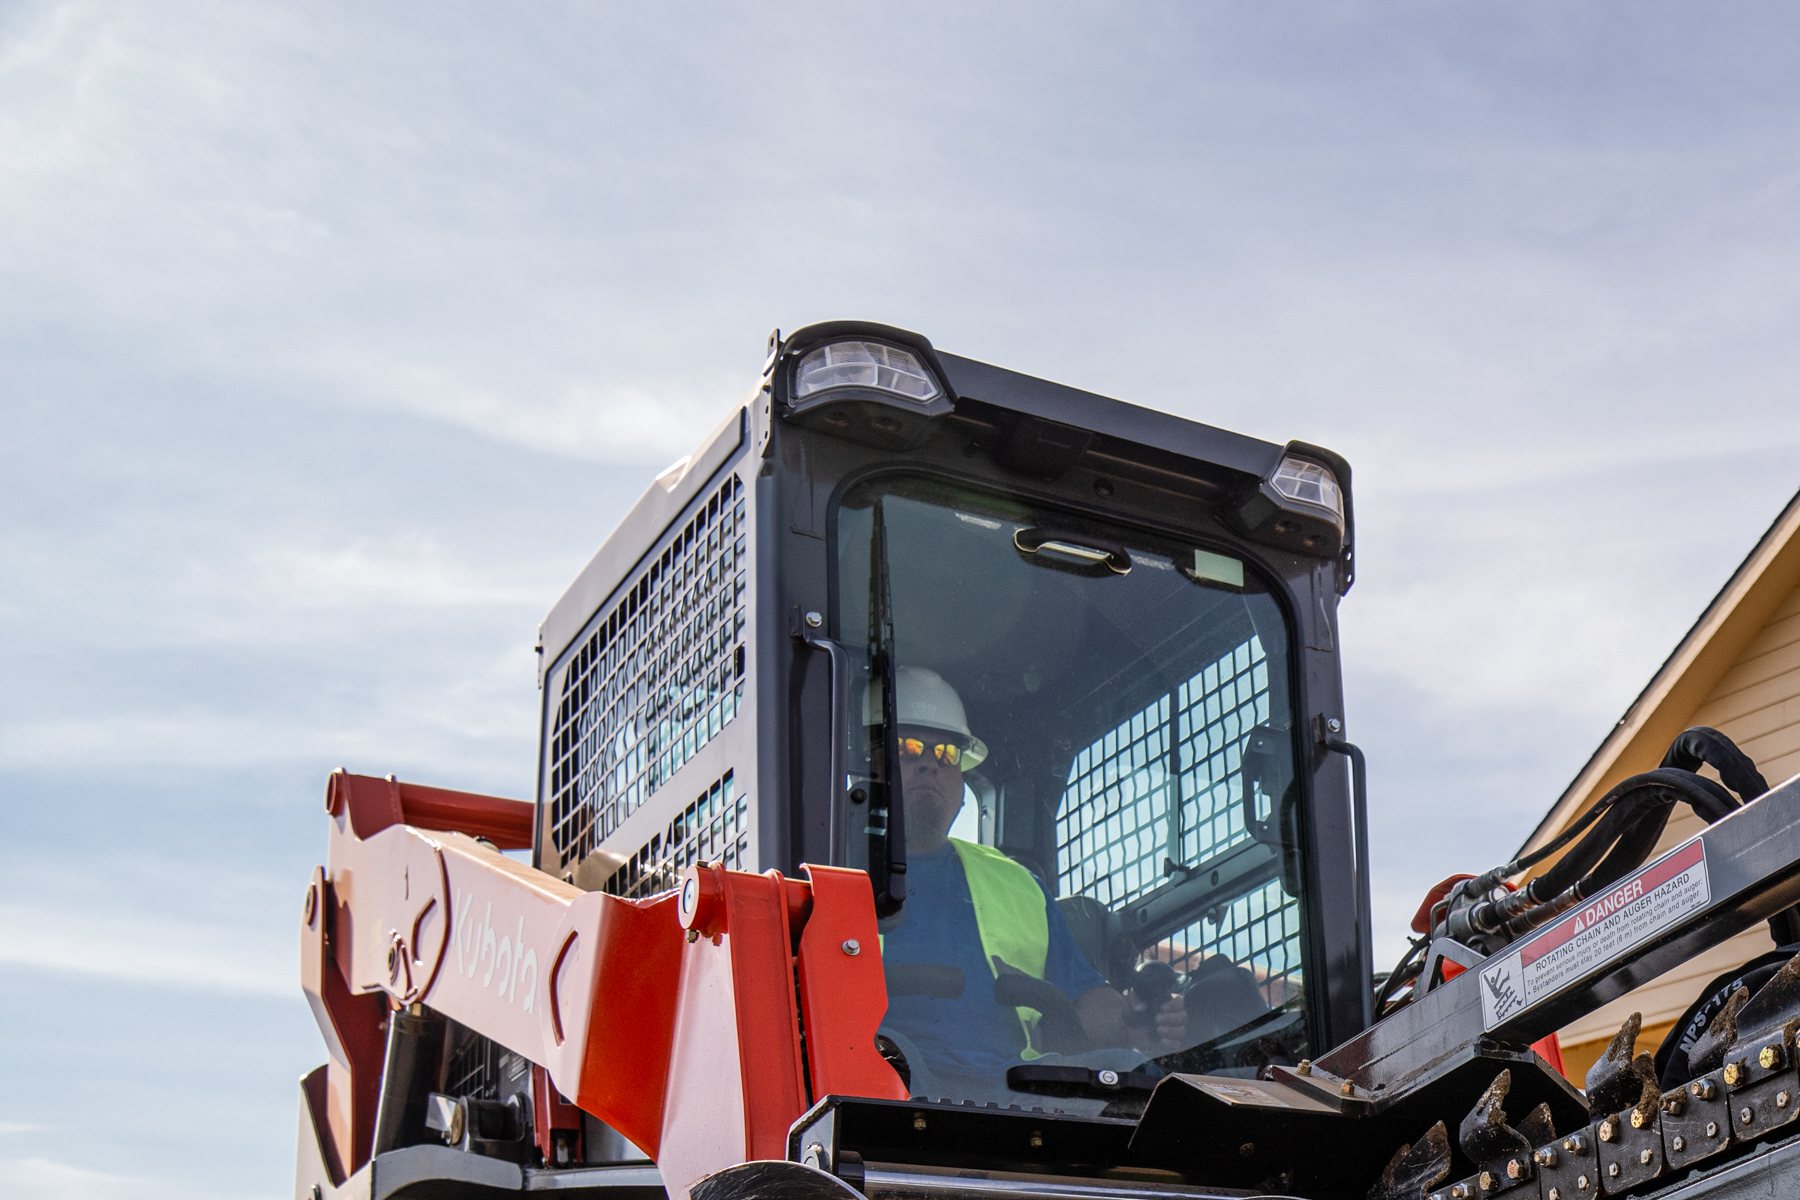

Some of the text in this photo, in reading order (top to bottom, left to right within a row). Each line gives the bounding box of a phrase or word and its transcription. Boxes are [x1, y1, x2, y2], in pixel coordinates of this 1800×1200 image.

[451, 888, 538, 1015] Kubota
[1527, 979, 1535, 987] To
[1535, 966, 1555, 983] prevent
[1556, 955, 1576, 972] serious
[1576, 945, 1591, 959] injury
[1600, 929, 1616, 944] death
[1616, 921, 1630, 934] from
[1631, 908, 1653, 926] rotating
[1654, 898, 1670, 912] chain
[1671, 889, 1683, 903] and
[1533, 972, 1564, 993] Bystanders
[1565, 961, 1580, 974] must
[1580, 953, 1593, 966] stay
[1594, 947, 1602, 958] 20
[1603, 940, 1616, 952] feet
[1616, 934, 1623, 946] (6
[1624, 929, 1633, 938] m)
[1634, 922, 1649, 934] from
[1649, 910, 1667, 924] chain
[1668, 901, 1680, 914] and
[1681, 891, 1702, 906] auger.
[1535, 873, 1690, 972] ROTATING CHAIN AND AUGER HAZARD
[1585, 879, 1644, 927] DANGER
[1679, 977, 1743, 1055] NPS-175
